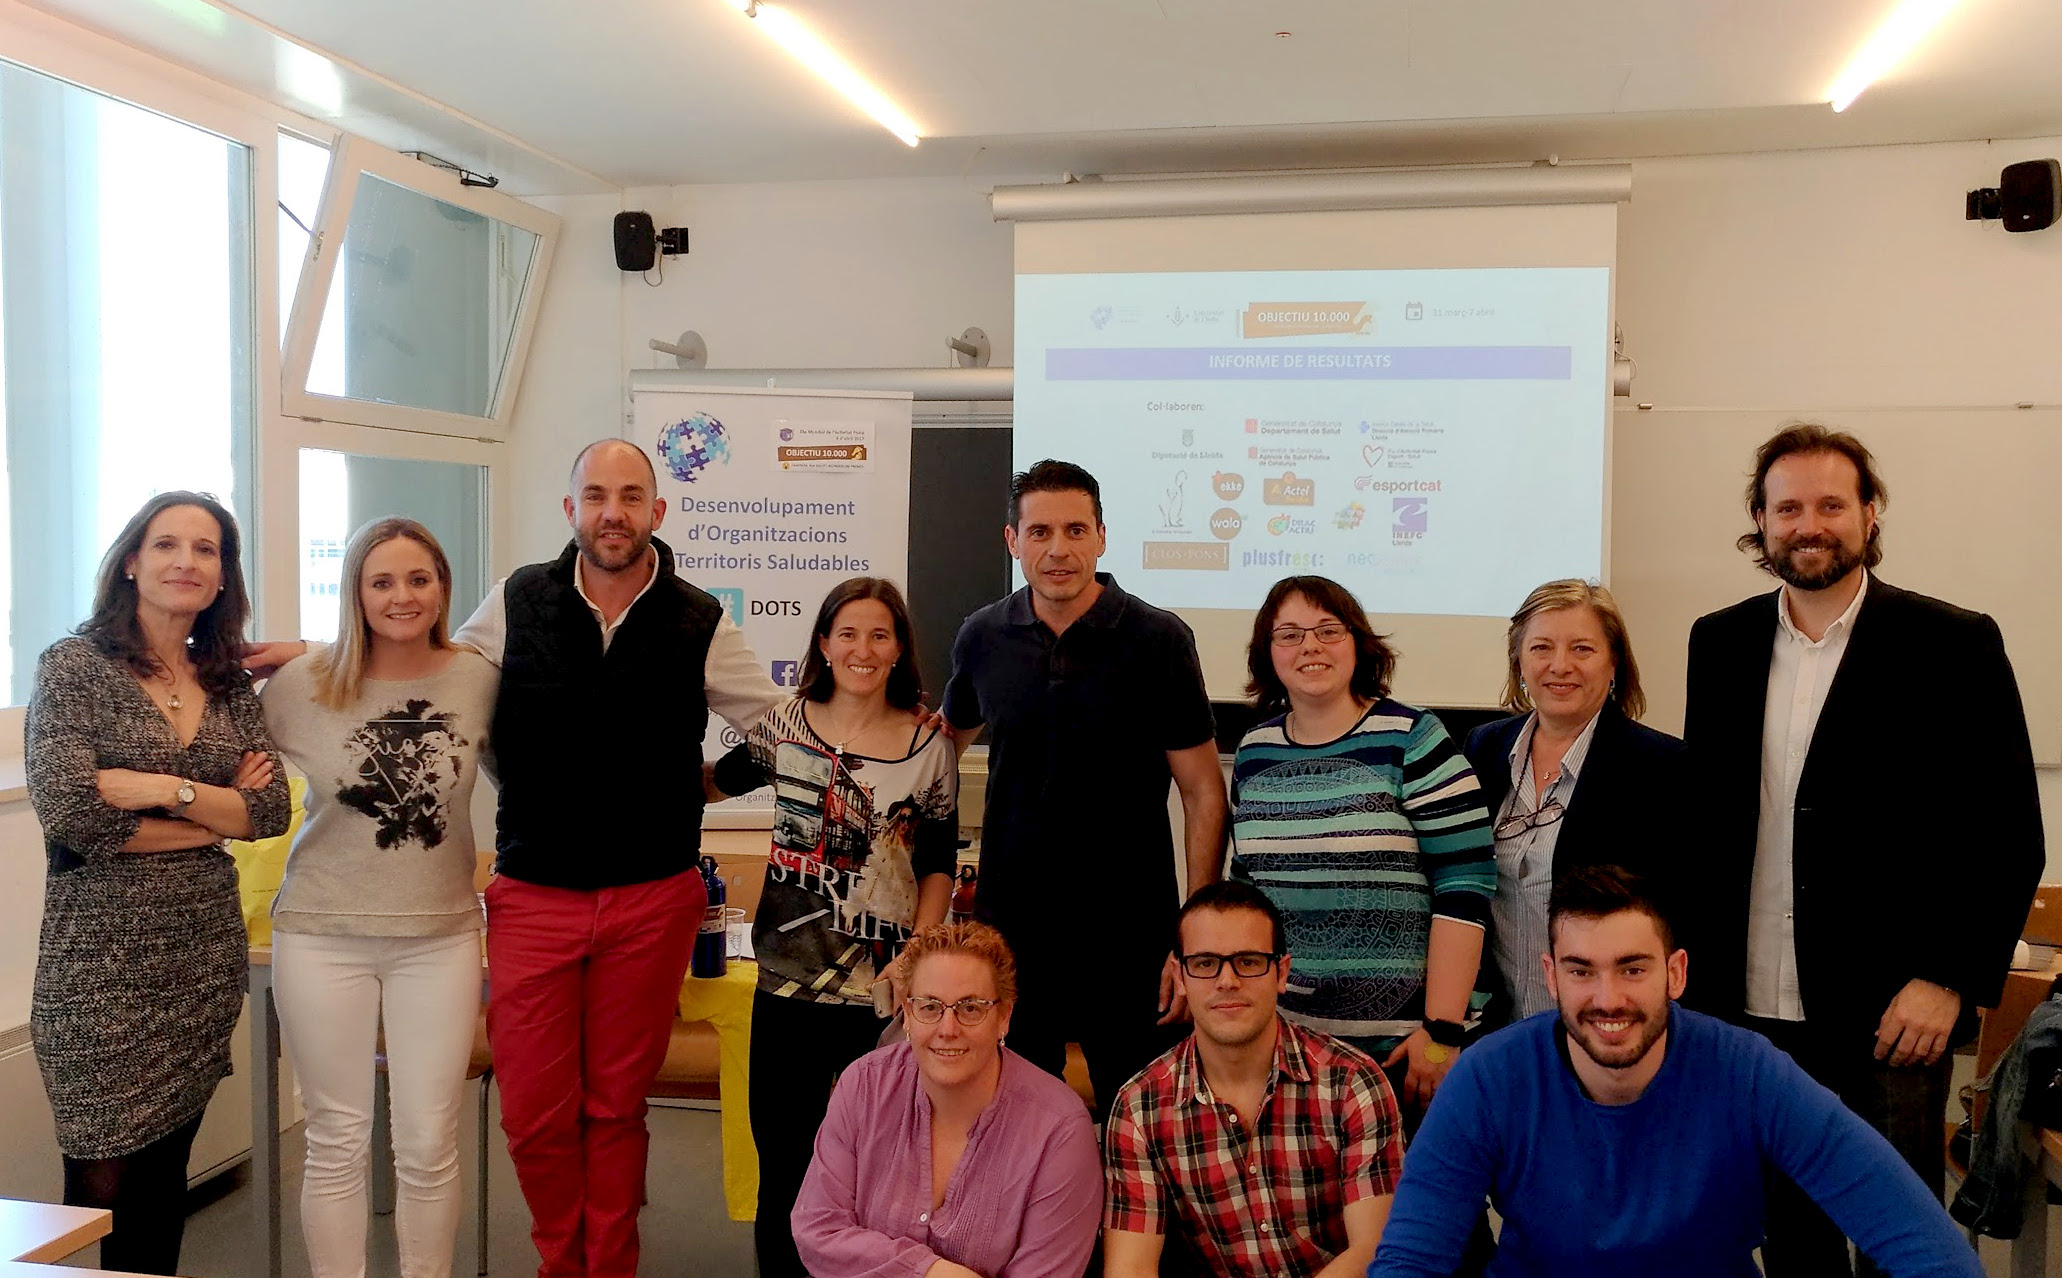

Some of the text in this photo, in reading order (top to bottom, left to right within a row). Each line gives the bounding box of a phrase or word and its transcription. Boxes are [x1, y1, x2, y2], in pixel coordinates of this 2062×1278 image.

[1257, 311, 1350, 323] OBJECTIU 10.000
[1209, 353, 1391, 368] INFORME DE RESULTATS
[1261, 427, 1341, 435] Departament de Salut
[785, 448, 848, 458] OBJECTIU 10.000
[1283, 484, 1311, 497] Actel
[1372, 480, 1443, 495] esportcat
[681, 497, 855, 518] Desenvolupament
[675, 552, 869, 571] Territoris Saludables
[750, 599, 802, 616] DOTS
